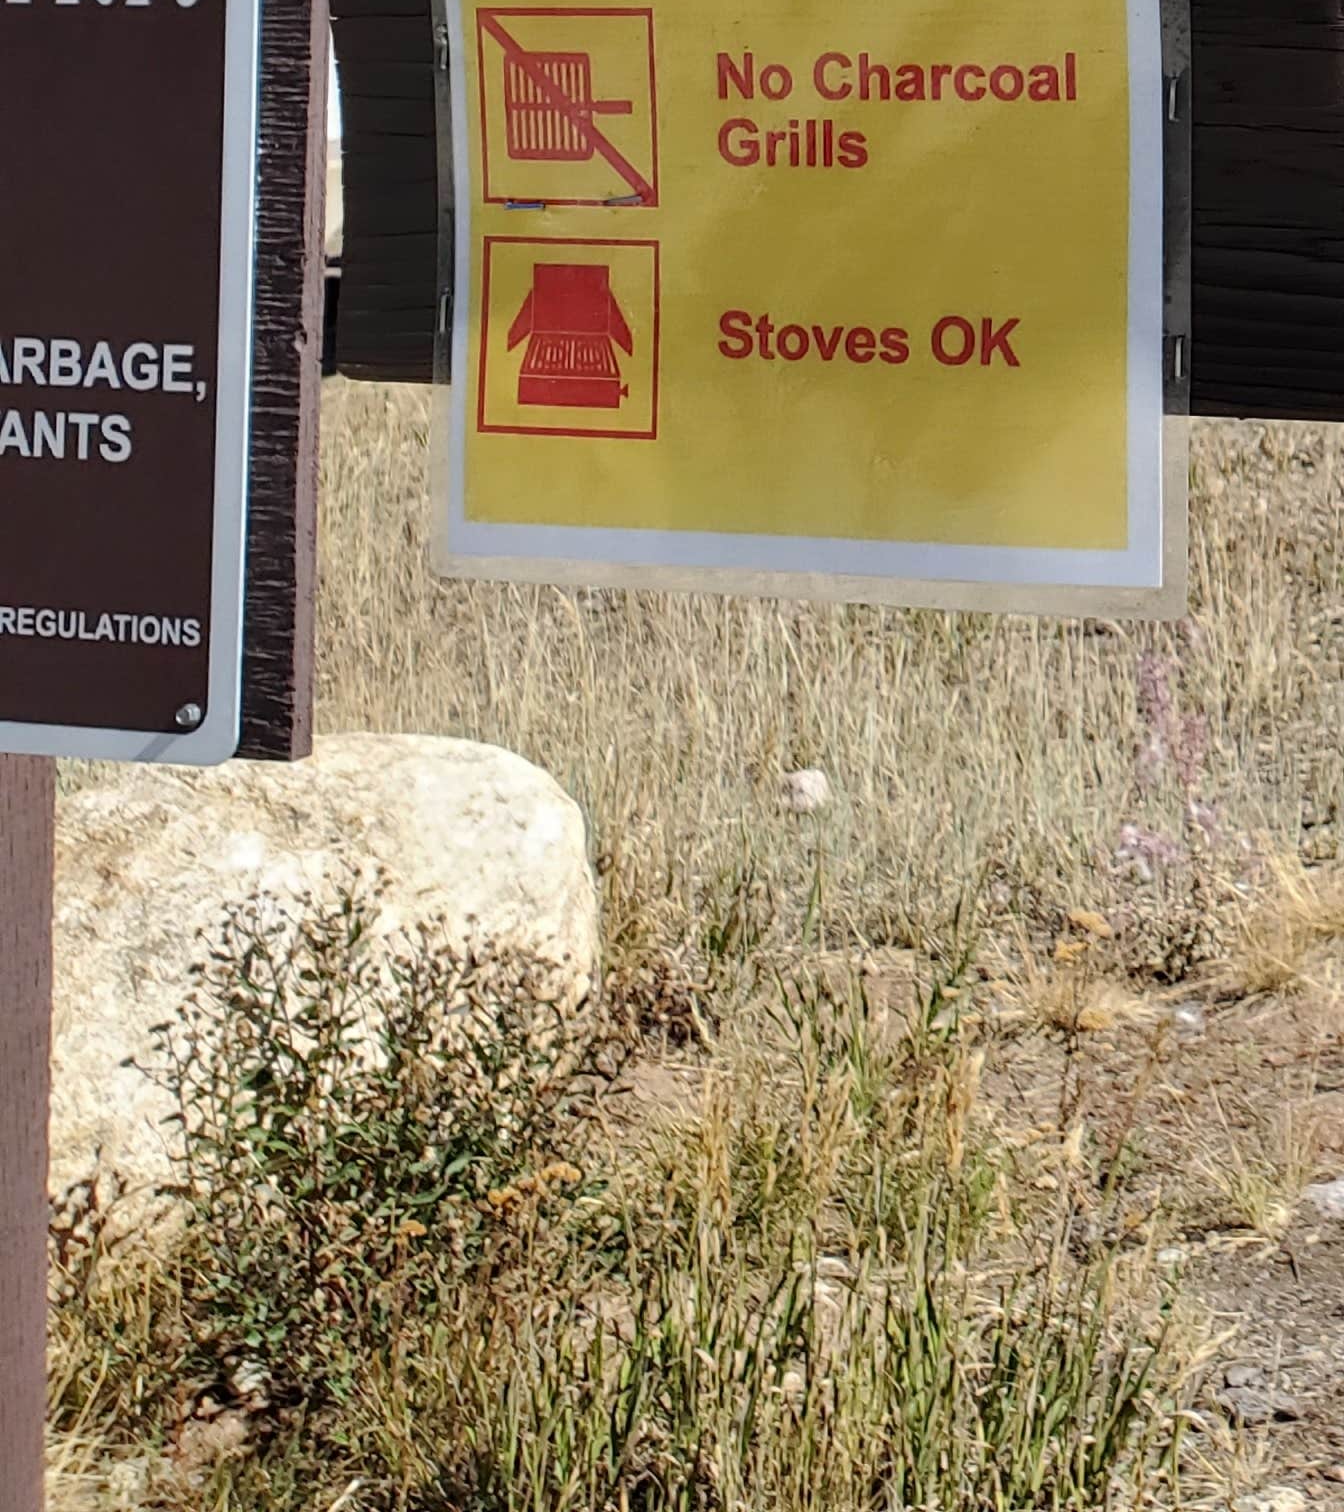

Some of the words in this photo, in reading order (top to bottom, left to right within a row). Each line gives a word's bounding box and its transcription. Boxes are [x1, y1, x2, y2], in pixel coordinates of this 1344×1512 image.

[717, 54, 791, 99] No
[822, 54, 1077, 103] Charcoal
[718, 118, 869, 169] Grills
[718, 310, 910, 365] Stoves
[931, 317, 1019, 366] OK
[0, 337, 207, 402] RBAGE,
[0, 606, 201, 647] REGULATIONS
